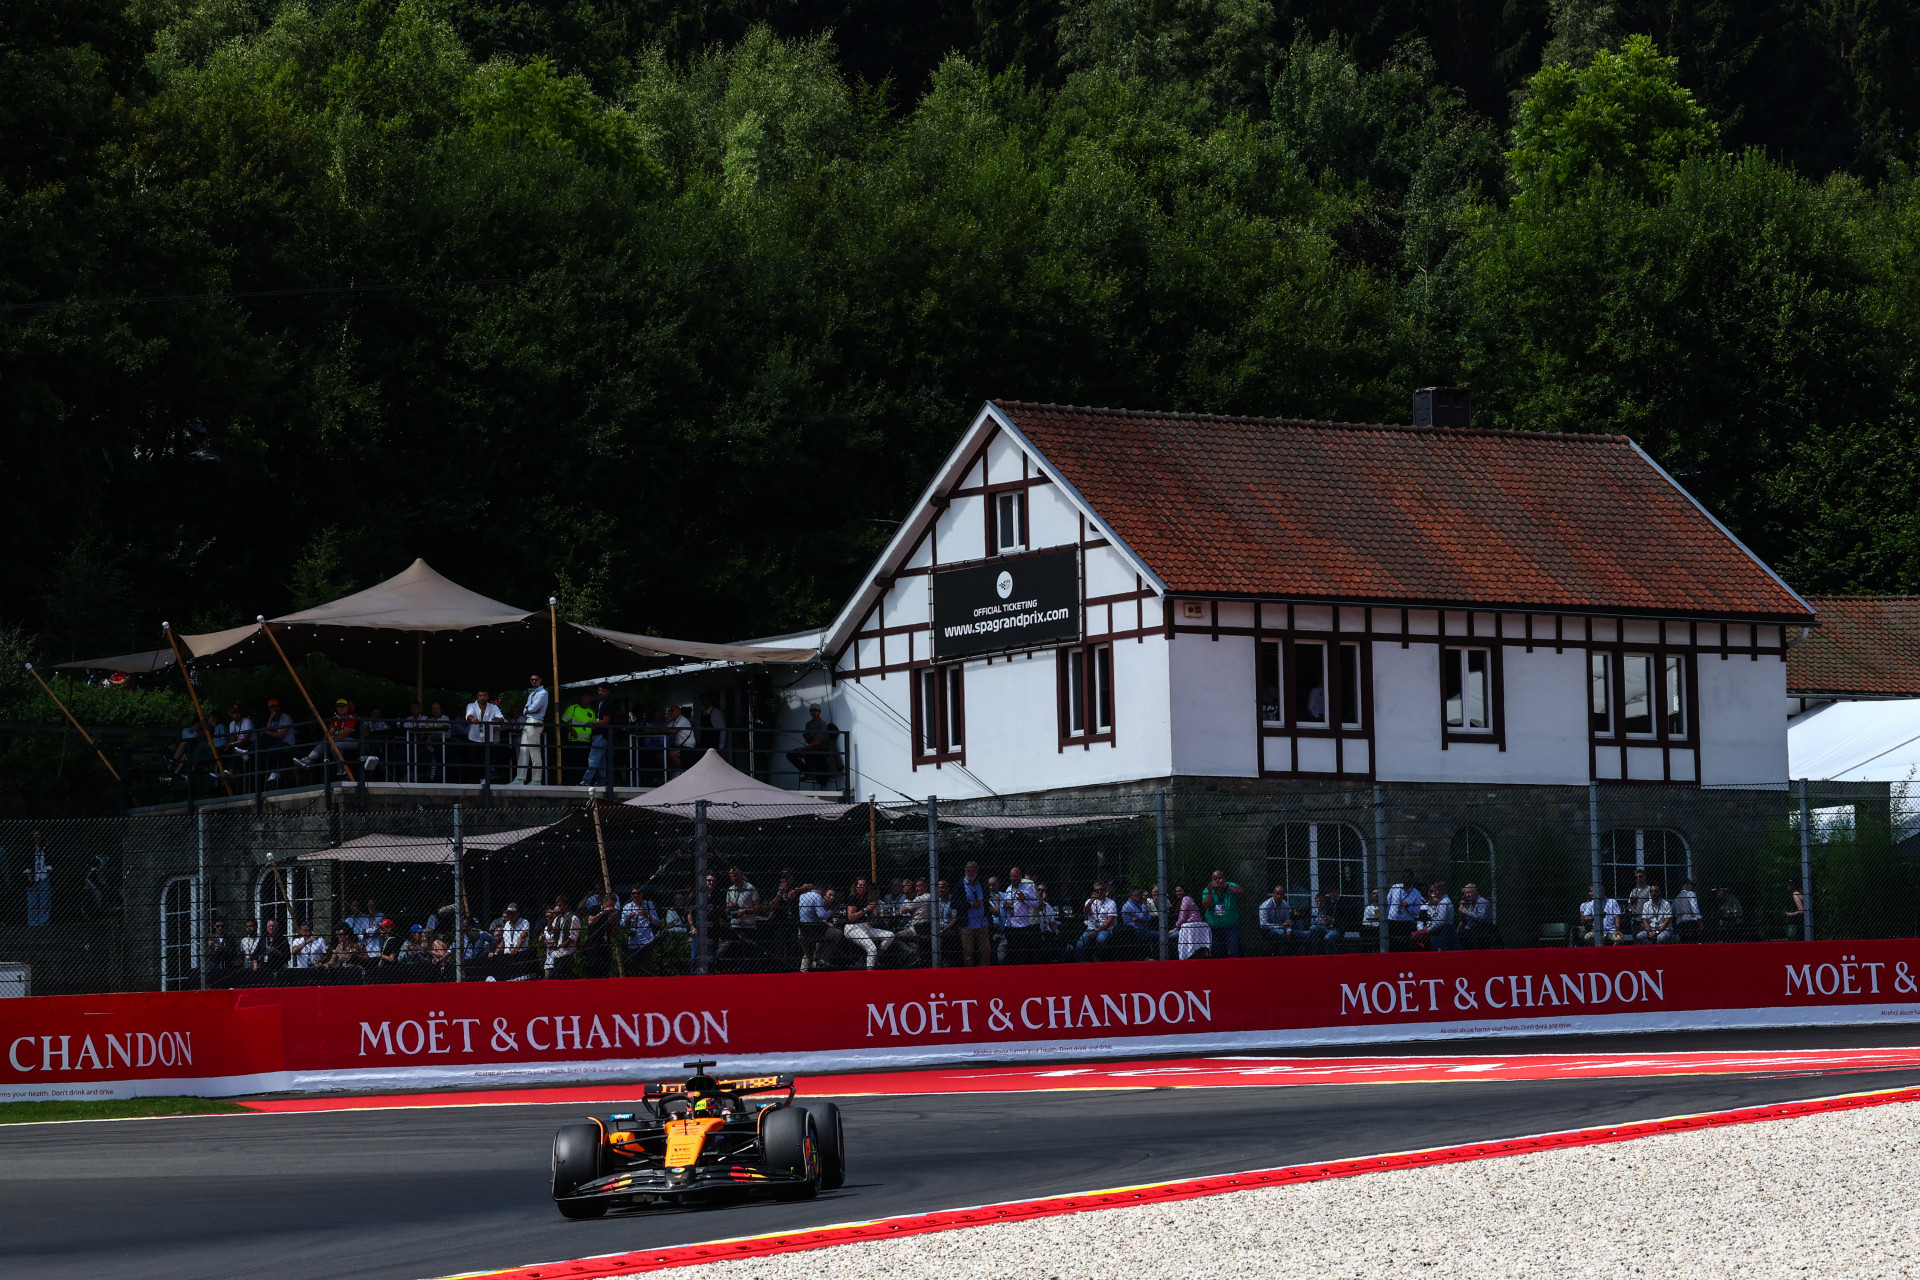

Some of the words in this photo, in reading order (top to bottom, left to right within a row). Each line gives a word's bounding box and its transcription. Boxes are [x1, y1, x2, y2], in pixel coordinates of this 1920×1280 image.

[944, 607, 1069, 638] www.spagrandprix.com
[973, 605, 1002, 617] OFFICIAL
[1002, 599, 1038, 612] TICKETING
[1340, 972, 1445, 1015] MOËT
[1453, 977, 1479, 1010] &
[1484, 969, 1664, 1009] CHANDON
[1785, 955, 1885, 996] MOËT
[1894, 961, 1918, 993] &
[358, 1010, 481, 1056] MOËT
[490, 1017, 519, 1052] &
[526, 1009, 729, 1051] CHANDON
[866, 992, 978, 1037] MOËT
[987, 997, 1014, 1031] &
[1020, 989, 1212, 1030] CHANDON
[8, 1031, 193, 1072] CHANDON
